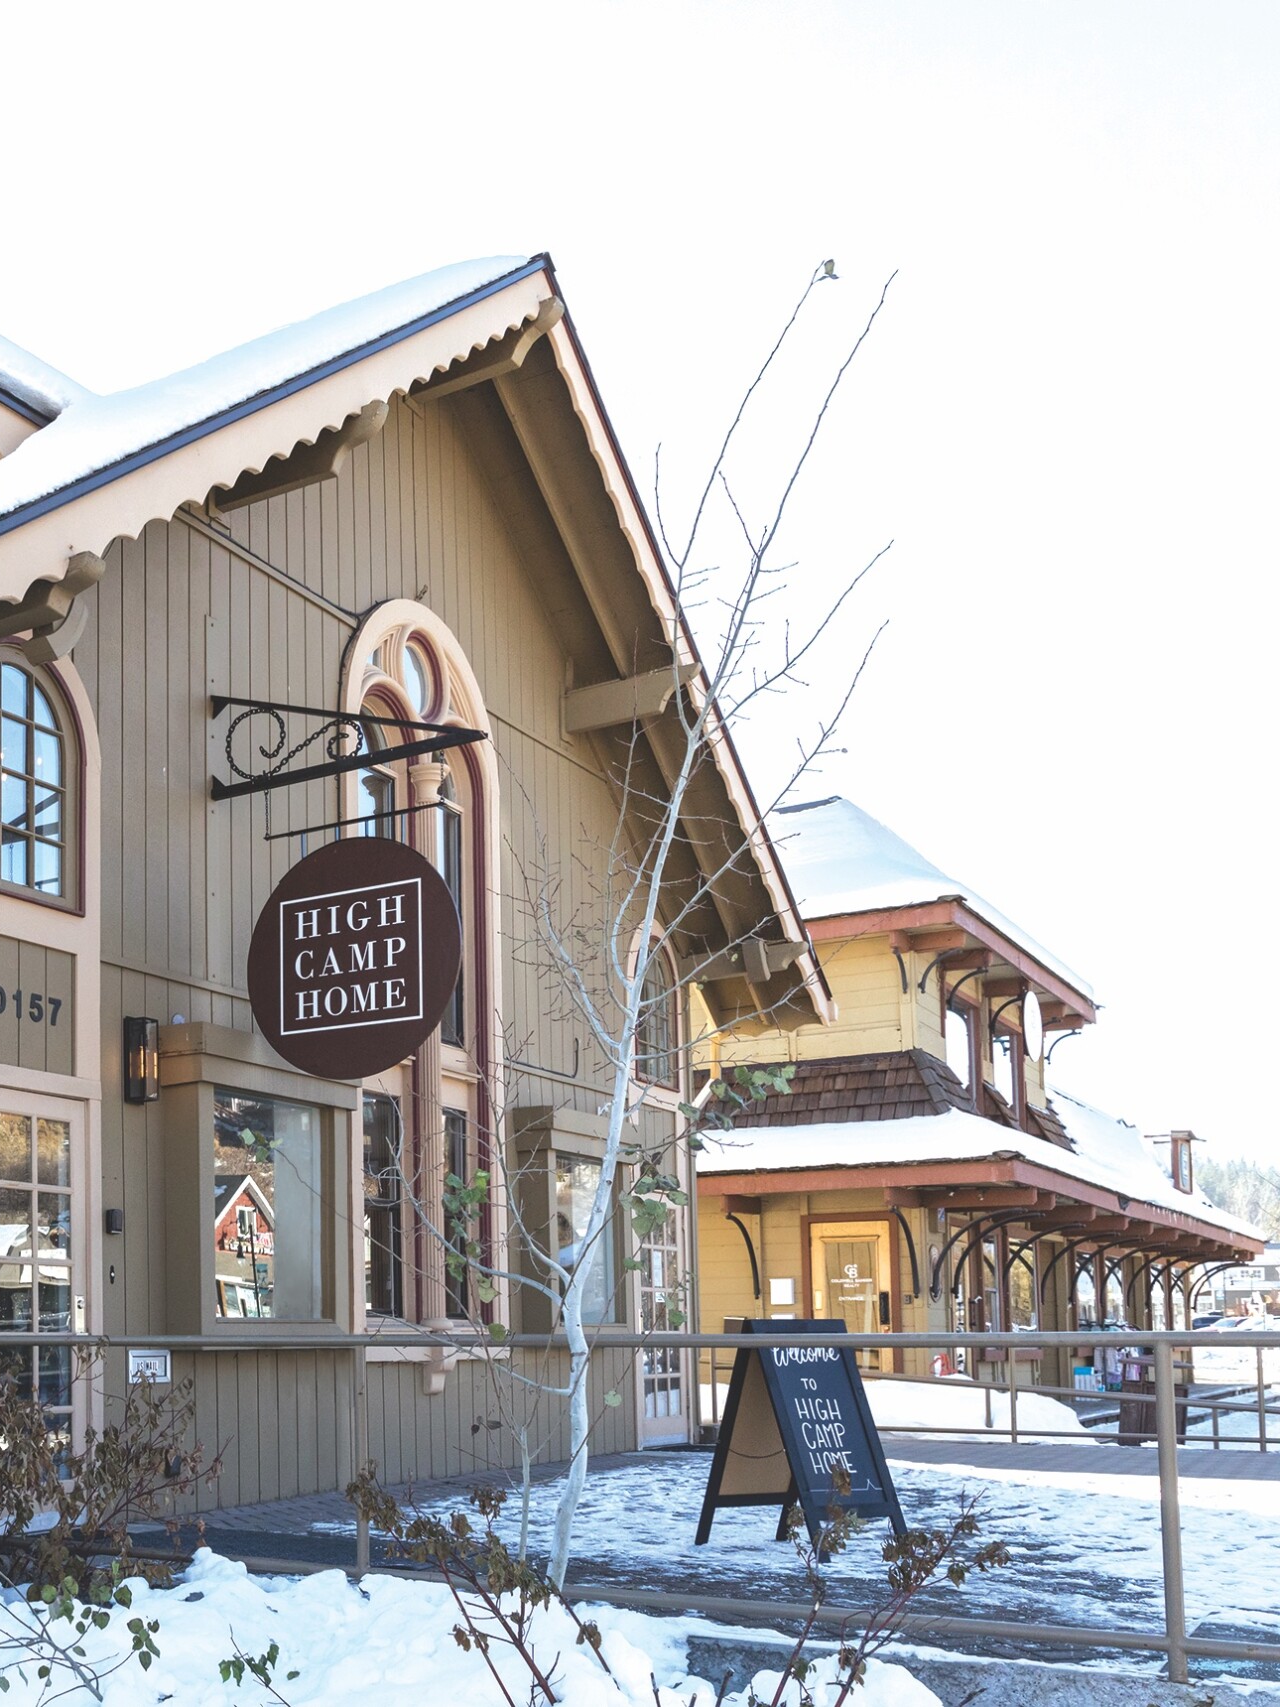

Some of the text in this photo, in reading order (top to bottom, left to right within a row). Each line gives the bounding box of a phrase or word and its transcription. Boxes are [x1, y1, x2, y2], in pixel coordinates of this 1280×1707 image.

[295, 894, 406, 941] HIGH
[295, 937, 407, 980] CAMP
[295, 978, 407, 1021] HOME
[800, 1378, 817, 1391] TO
[794, 1398, 841, 1420] HIGH
[801, 1422, 846, 1449] CAMP
